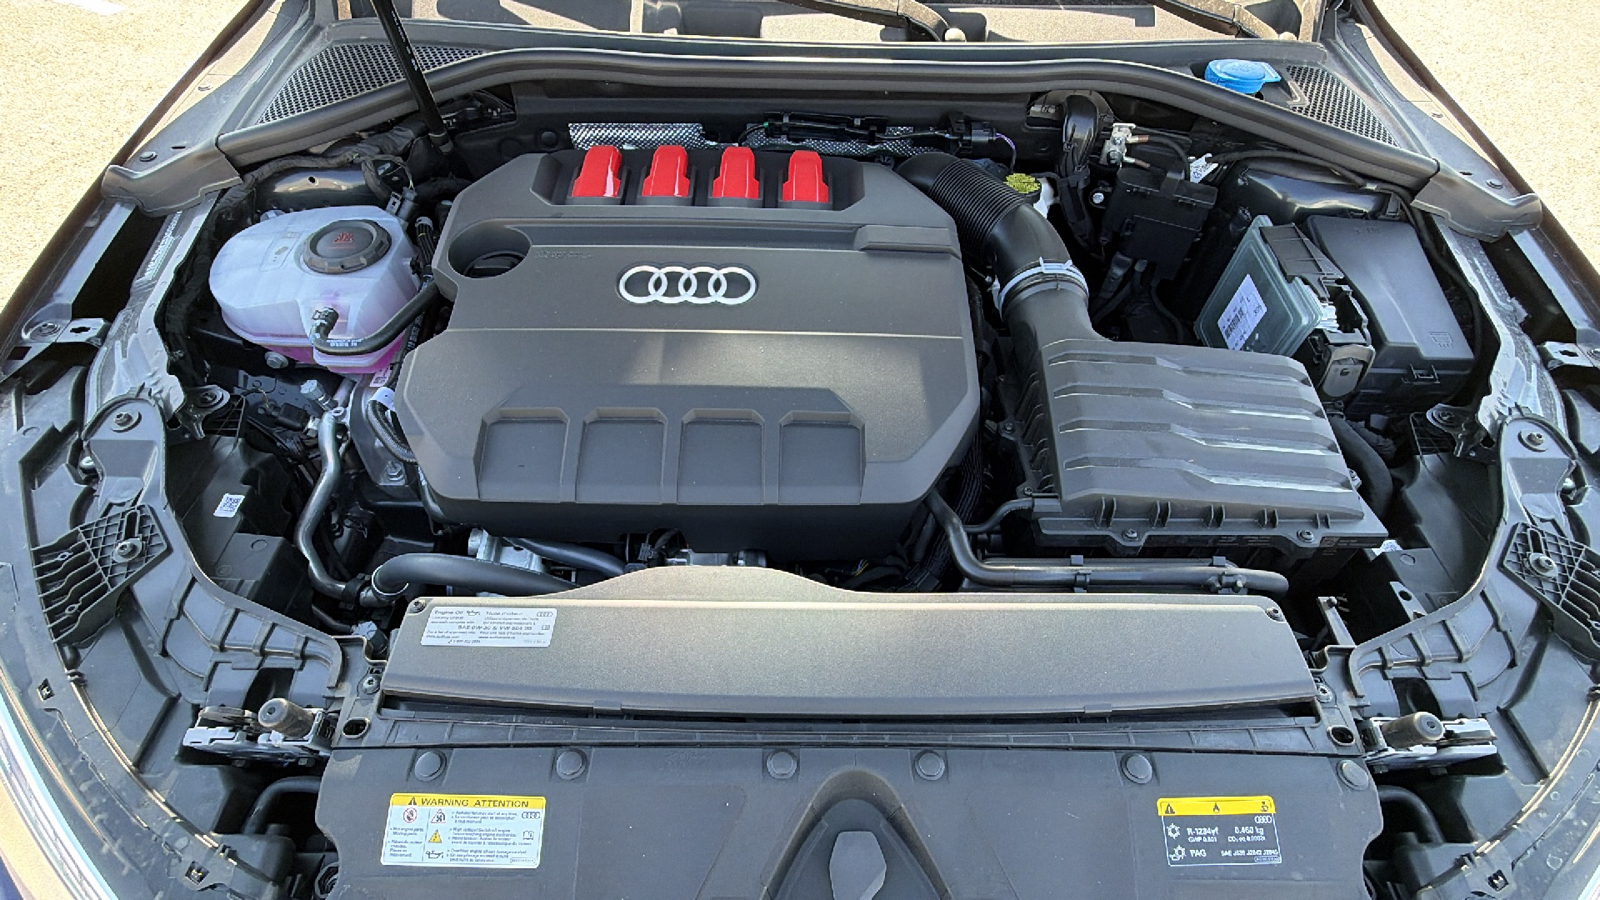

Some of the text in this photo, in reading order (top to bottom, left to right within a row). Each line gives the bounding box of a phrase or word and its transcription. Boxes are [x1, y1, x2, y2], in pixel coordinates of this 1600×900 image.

[421, 798, 529, 807] WARNING ATTENTION
[1186, 827, 1219, 836] R-1234yf
[1255, 826, 1264, 835] kg
[1190, 849, 1207, 857] PAG
